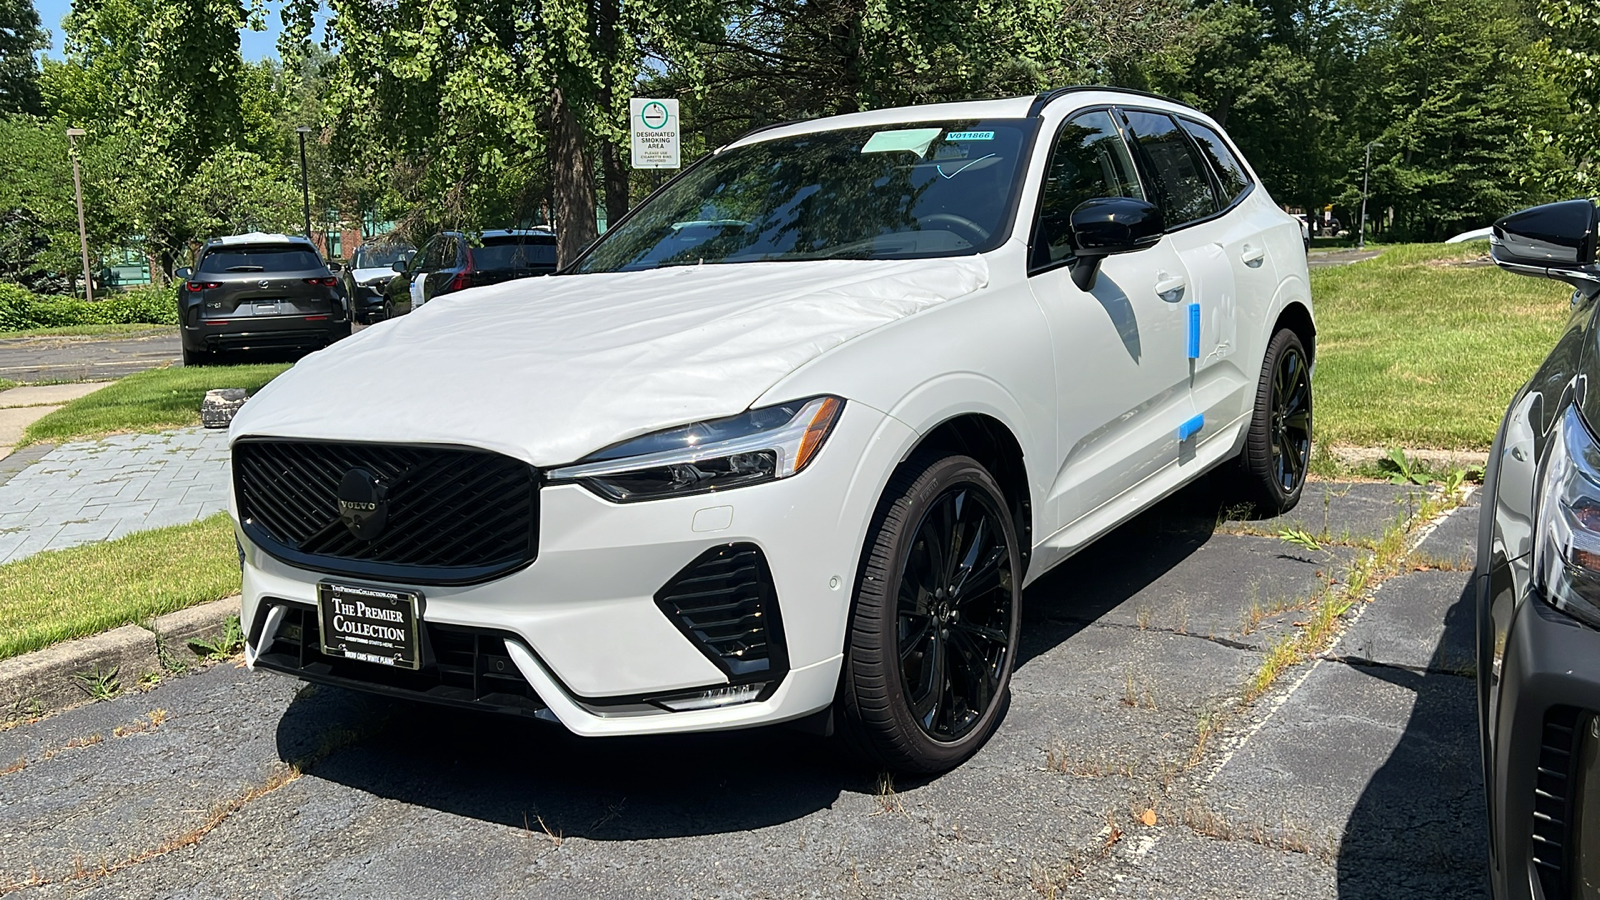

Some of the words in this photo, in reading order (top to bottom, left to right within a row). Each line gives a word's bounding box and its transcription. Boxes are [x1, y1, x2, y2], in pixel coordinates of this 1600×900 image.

[340, 500, 376, 510] VOLVO
[332, 598, 355, 616] THE
[356, 601, 404, 623] PREMIER
[333, 614, 404, 642] COLLECTION
